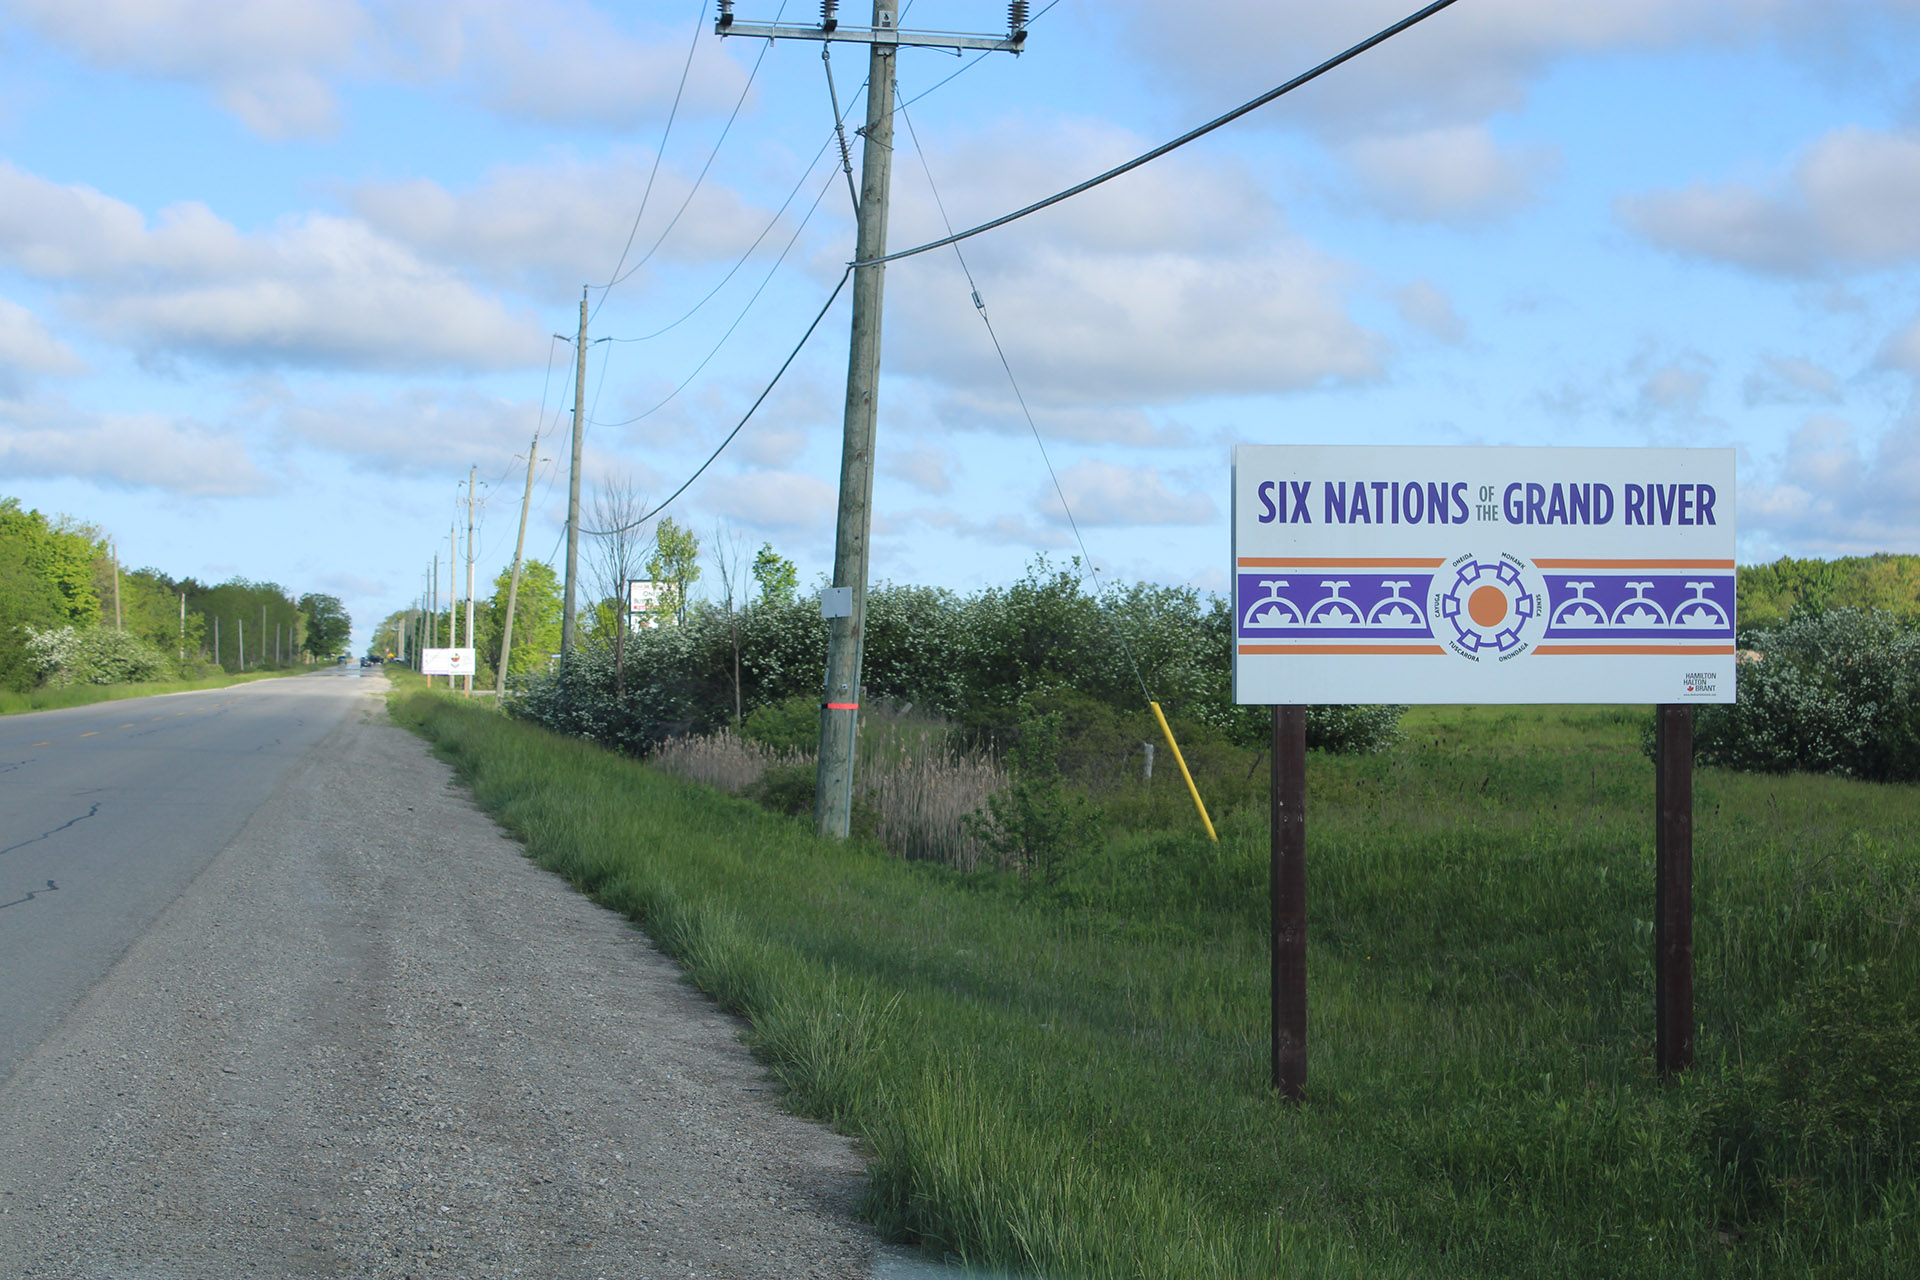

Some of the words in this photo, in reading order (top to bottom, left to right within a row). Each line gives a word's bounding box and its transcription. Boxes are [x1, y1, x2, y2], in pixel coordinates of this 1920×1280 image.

[1258, 481, 1312, 524] SIX
[1324, 481, 1469, 525] NATIONS
[1479, 486, 1495, 503] OF
[1503, 482, 1615, 526] GRAND
[1625, 483, 1717, 526] RIVER
[1476, 505, 1498, 522] THE
[1452, 552, 1473, 568] ONEIDA
[1501, 552, 1526, 570] MOHAWK
[1448, 640, 1480, 663] TUSCARORA
[1498, 642, 1529, 663] ONONDAGA
